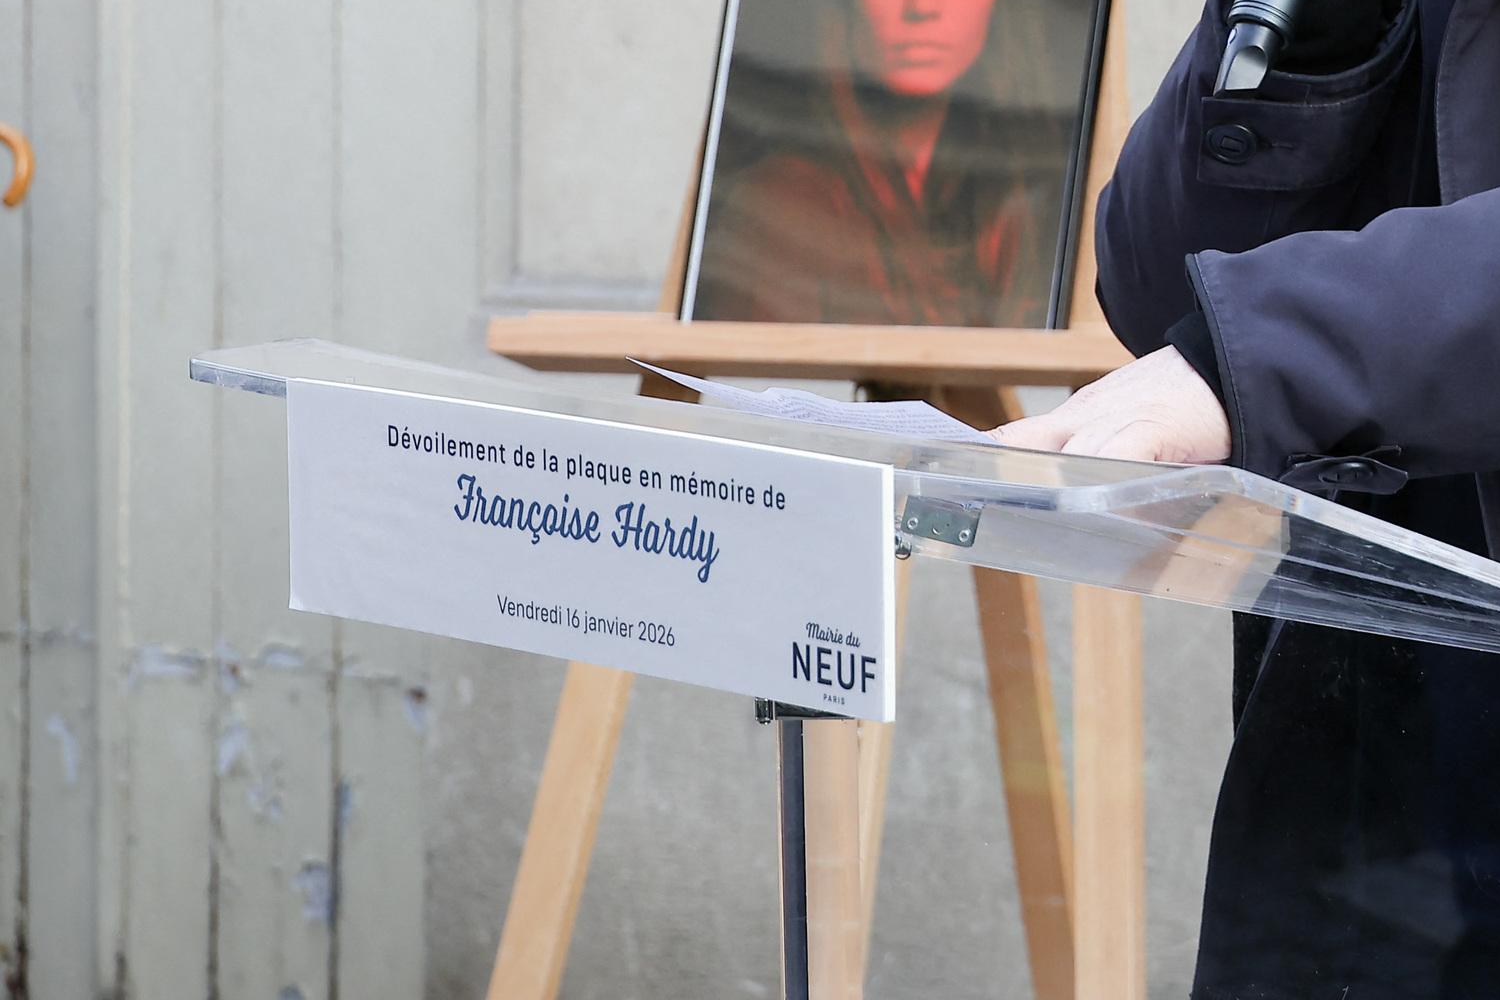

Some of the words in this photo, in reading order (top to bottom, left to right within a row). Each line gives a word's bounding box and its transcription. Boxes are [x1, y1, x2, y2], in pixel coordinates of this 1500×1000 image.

[388, 425, 506, 464] Dévoilement
[513, 445, 535, 469] de
[543, 448, 558, 472] la
[567, 454, 632, 485] plaque
[639, 469, 662, 489] en
[670, 471, 755, 505] mémoire
[763, 485, 786, 510] de
[454, 473, 601, 544] Françoise
[611, 501, 720, 583] Hardy
[497, 594, 562, 625] Vendredi
[566, 608, 580, 629] 16
[584, 611, 634, 634] janvier
[638, 620, 675, 647] 2026
[806, 622, 843, 644] Mairie
[845, 632, 861, 648] du
[792, 641, 877, 693] NEUF
[823, 693, 845, 705] PARIS
